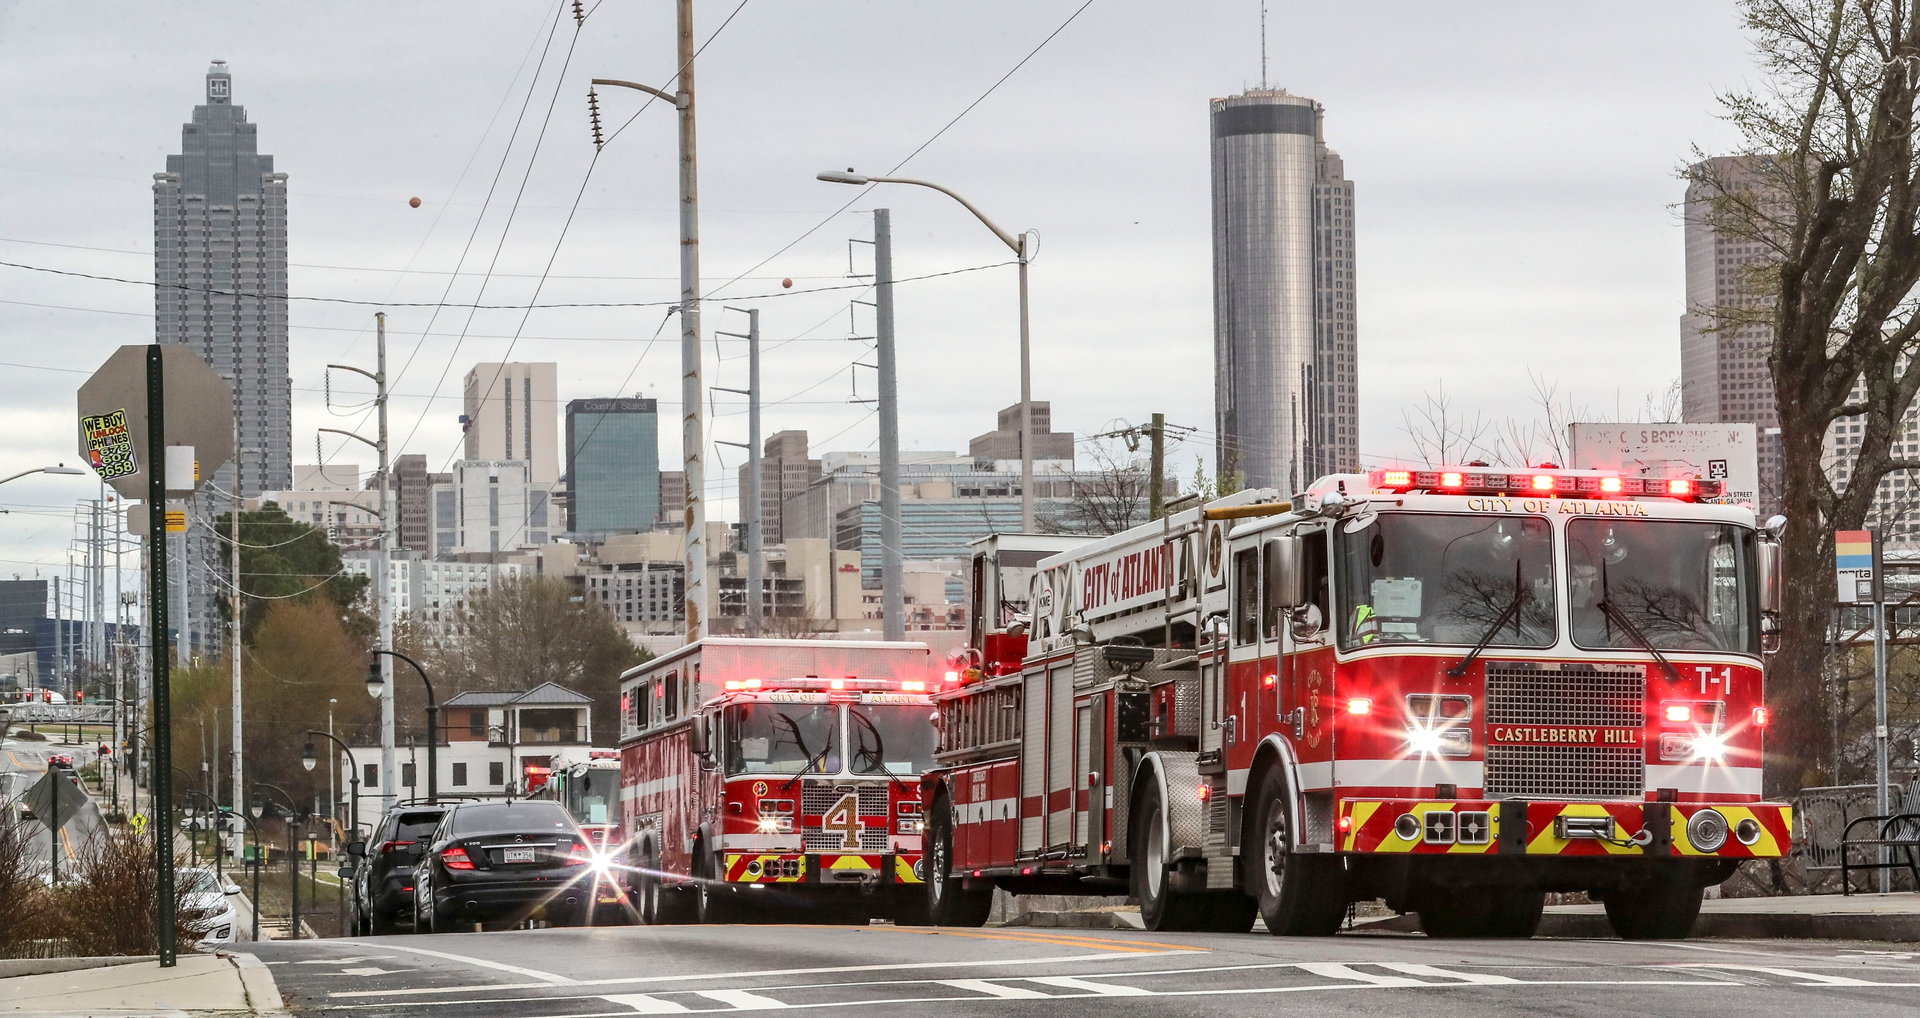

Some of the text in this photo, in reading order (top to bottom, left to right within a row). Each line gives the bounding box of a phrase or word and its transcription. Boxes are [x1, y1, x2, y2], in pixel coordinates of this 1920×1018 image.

[584, 401, 648, 410] Coastal States
[85, 413, 123, 432] WE BUY
[89, 433, 128, 450] IPHNES
[100, 443, 130, 456] 678
[102, 451, 131, 464] 607
[96, 461, 134, 478] 5658
[1467, 498, 1649, 516] CITY OF ATLANTA
[1083, 542, 1174, 612] CITY of ATLANTA
[1695, 666, 1731, 695] T-1
[800, 694, 815, 702] OF
[871, 695, 921, 703] ATLANTA
[1494, 727, 1637, 744] CASTLEBERRY HILL
[822, 793, 866, 850] 4
